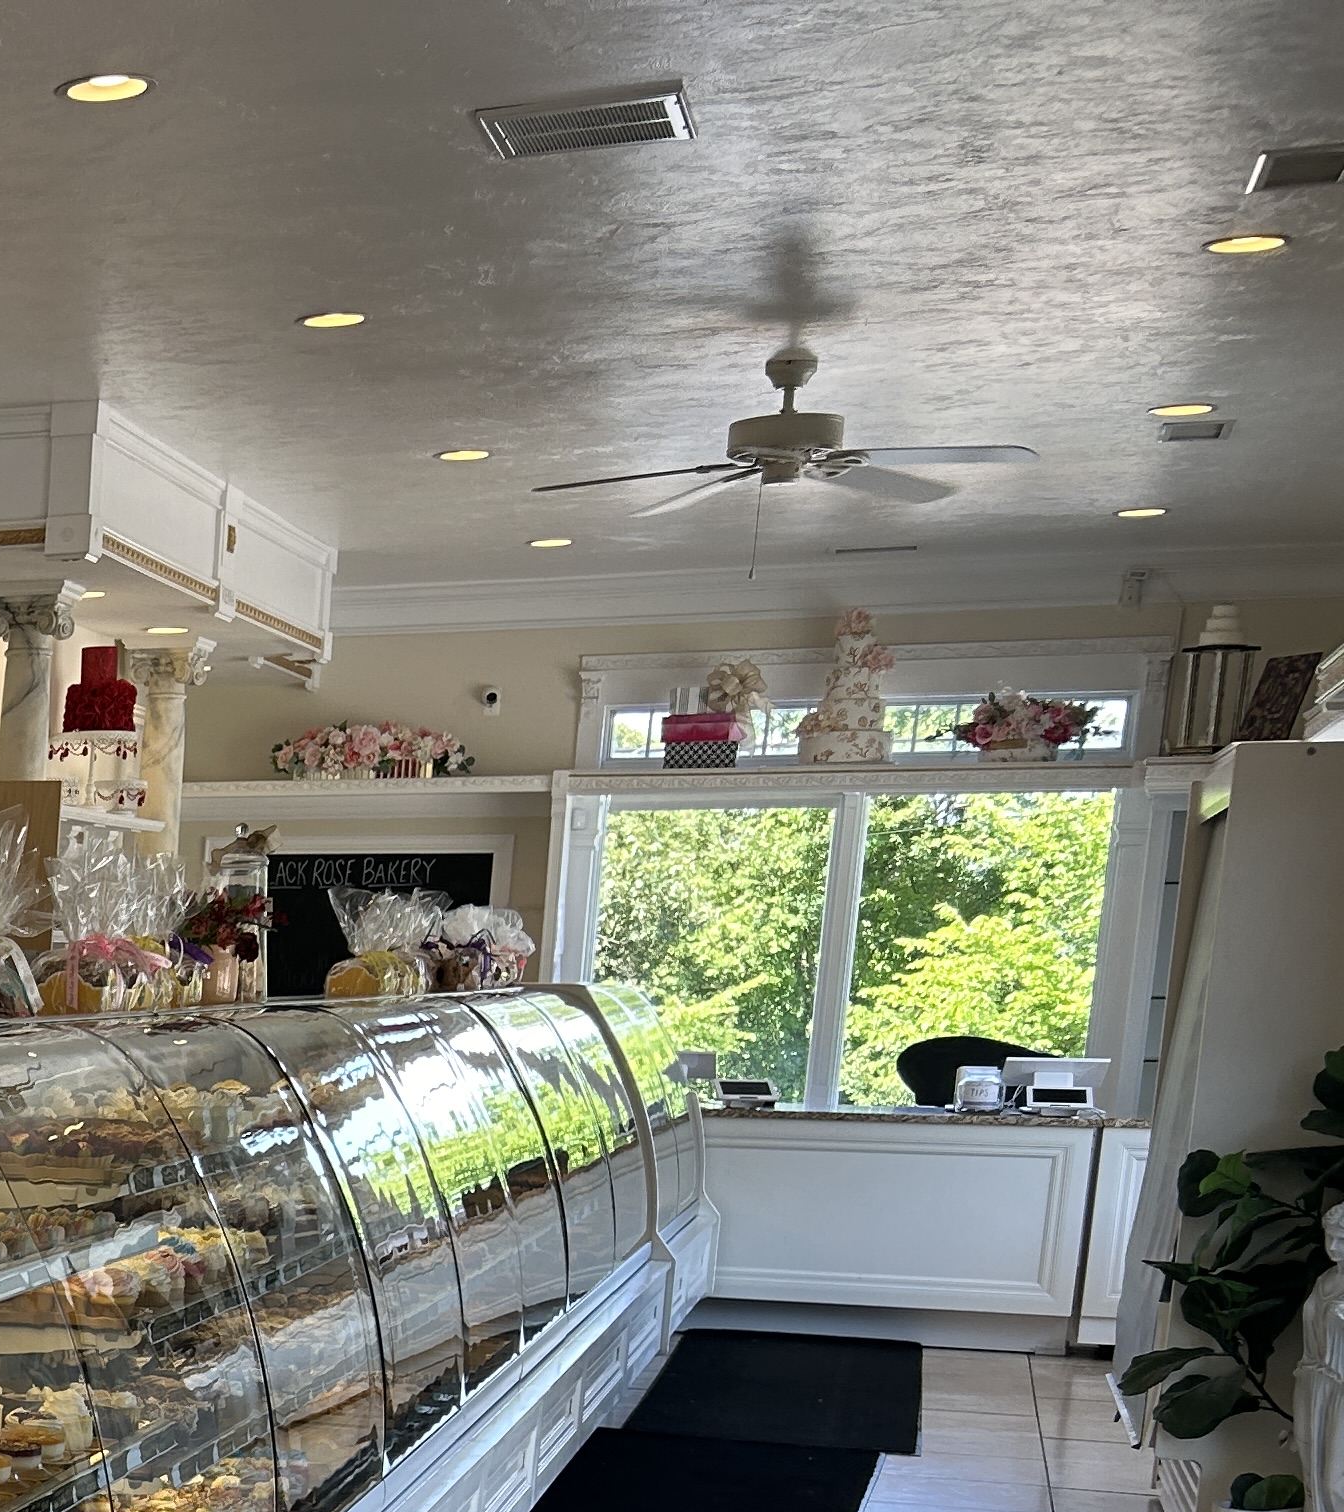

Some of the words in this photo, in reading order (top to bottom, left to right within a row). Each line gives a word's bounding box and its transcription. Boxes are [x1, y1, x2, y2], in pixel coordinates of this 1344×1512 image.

[269, 859, 309, 886] ACK
[312, 857, 357, 886] ROSE
[362, 856, 437, 886] BAKERY
[970, 1087, 989, 1098] TIPS
